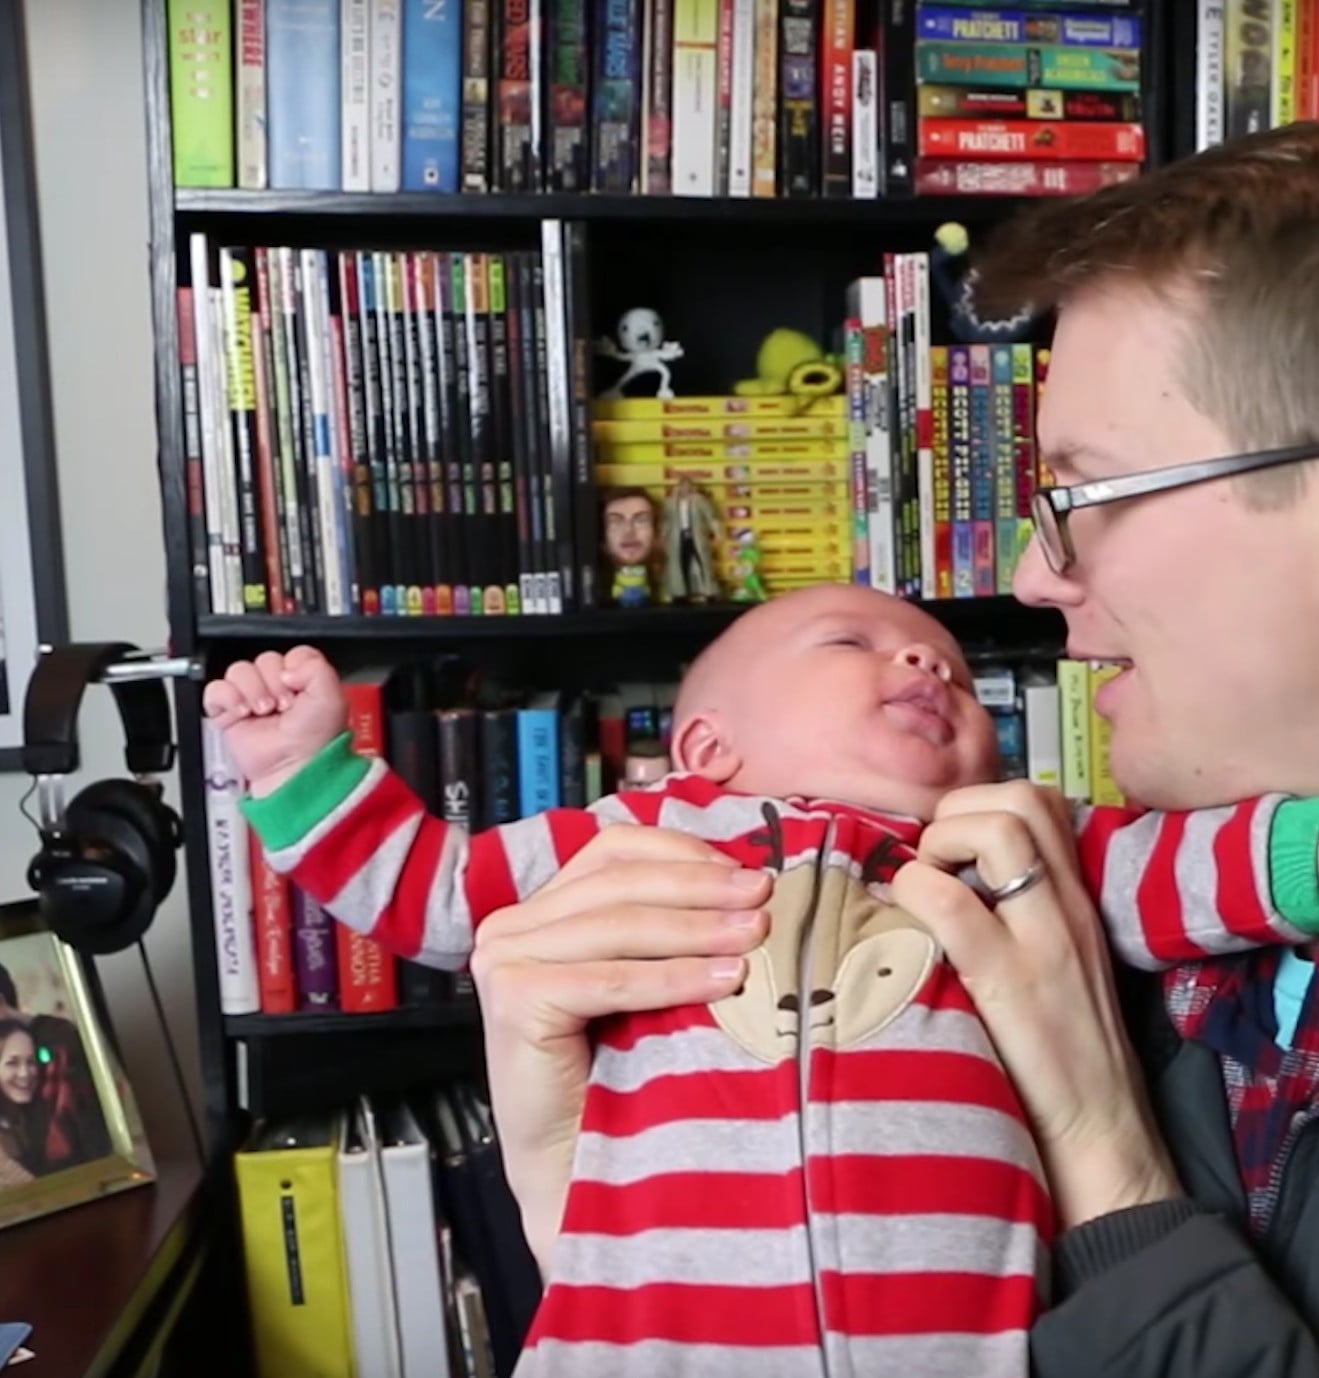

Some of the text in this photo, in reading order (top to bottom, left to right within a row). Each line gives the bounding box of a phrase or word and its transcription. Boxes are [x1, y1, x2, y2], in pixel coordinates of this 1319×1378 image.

[1207, 31, 1220, 84] TYLER
[953, 386, 969, 441] SCOTT
[955, 446, 970, 520] PILGRIM
[350, 931, 367, 987] ANNON
